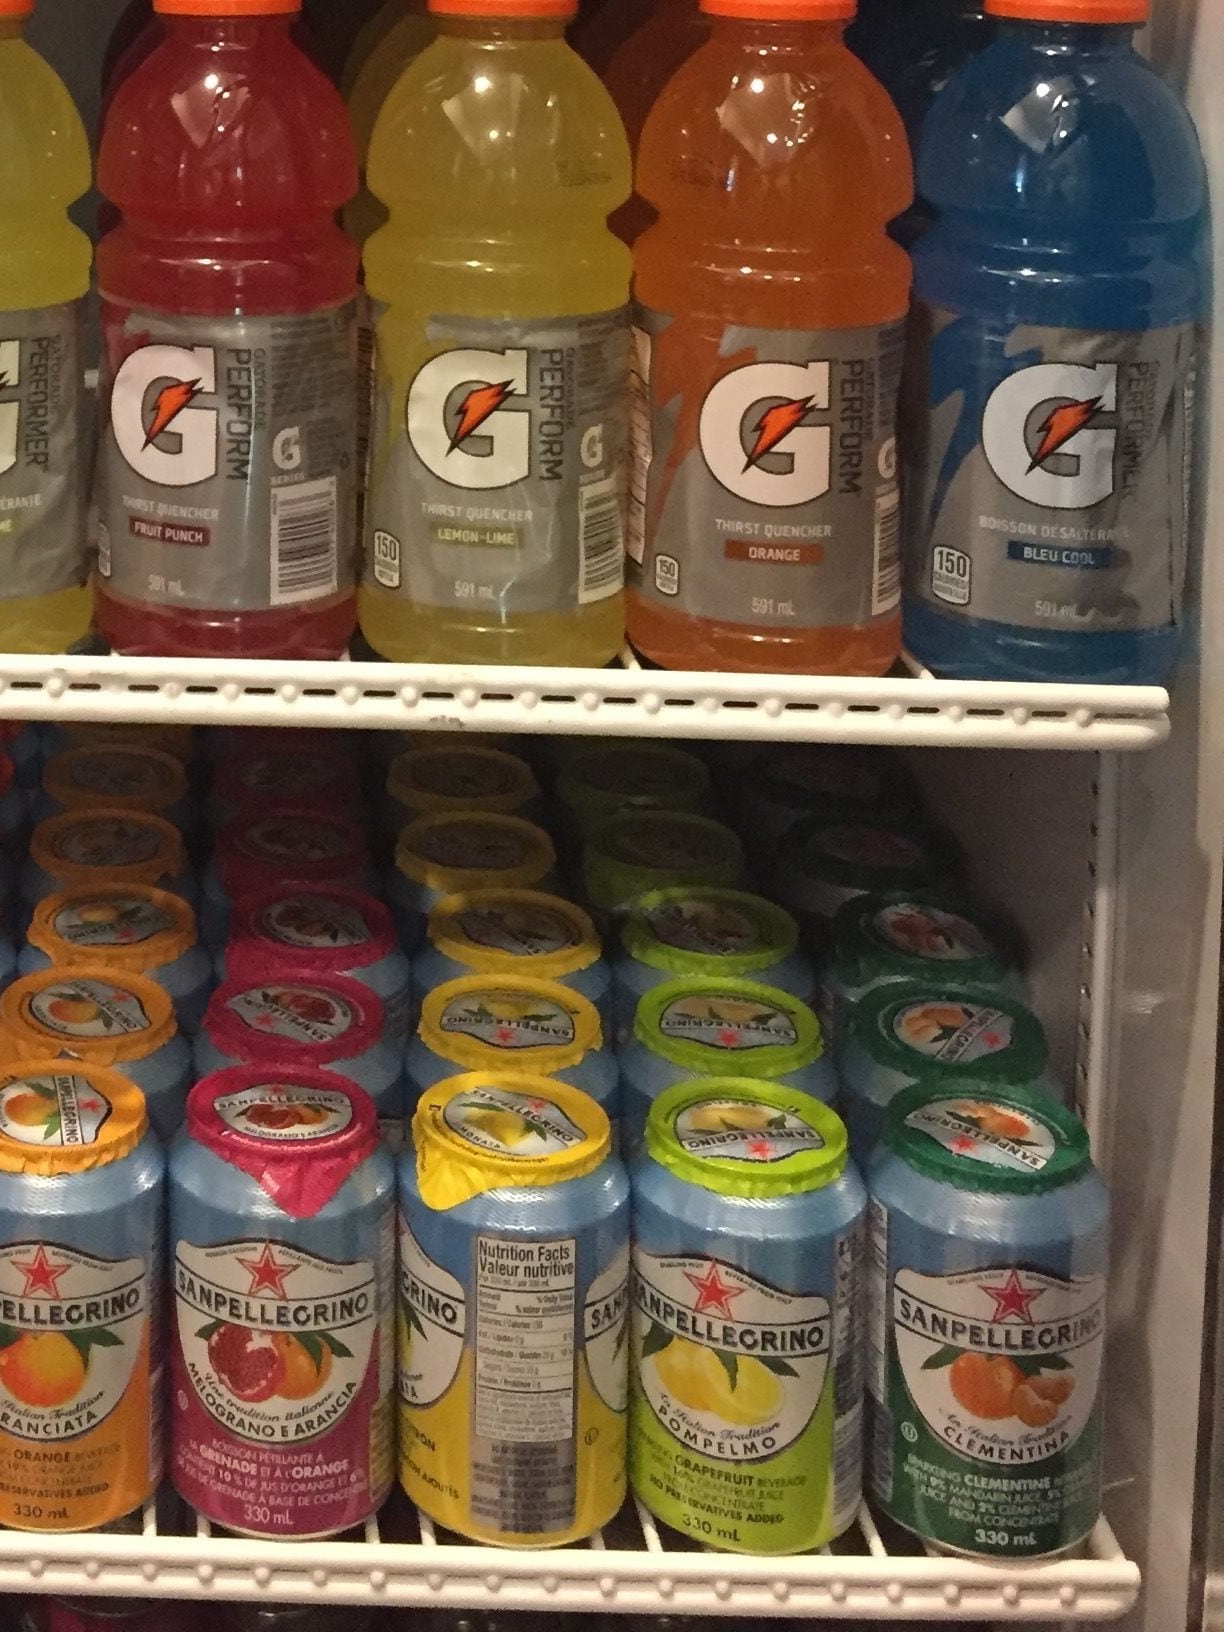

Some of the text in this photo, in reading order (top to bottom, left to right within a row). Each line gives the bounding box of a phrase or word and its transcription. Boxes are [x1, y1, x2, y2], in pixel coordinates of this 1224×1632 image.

[26, 336, 49, 469] PERFORMER
[226, 348, 252, 480] PERFORM
[538, 348, 564, 481] PERFORM
[111, 344, 217, 487] G
[407, 346, 531, 490] G
[839, 360, 863, 494] PERFORM
[580, 424, 603, 468] G
[699, 360, 831, 508] G
[982, 362, 1118, 510] G
[272, 426, 301, 470] G
[158, 502, 219, 520] QUENCHER
[422, 502, 533, 521] THIRST QUENCHER
[134, 521, 203, 543] FRUIT PUNCH
[437, 527, 514, 545] LEMON-LIME
[716, 519, 832, 538] THIRST QUENCHER
[979, 515, 1036, 535] BOISSON
[376, 534, 397, 561] 150
[748, 547, 801, 561] ORANGE
[1024, 547, 1096, 565] BLEU COOL
[659, 558, 675, 577] 150
[937, 549, 967, 578] 150
[455, 580, 476, 597] 591
[752, 598, 795, 616] 591 mL
[479, 1239, 570, 1262] Nutrition Facts
[479, 1256, 574, 1278] Valeur nutritive
[178, 1271, 369, 1326] SANPELLEGRINO
[639, 1281, 824, 1351] ANPELLEGRINO
[188, 1362, 357, 1438] MELOGRANO E ARANCIA
[658, 1404, 777, 1456] POMPELMO
[943, 1425, 1071, 1460] CLEMENTINA
[13, 1449, 71, 1463] ORANGE
[199, 1444, 258, 1476] GRENADE
[219, 1469, 232, 1482] 10
[260, 1479, 277, 1492] JUS
[676, 1454, 755, 1485] GRAPEFRUIT
[964, 1474, 1051, 1490] CLEMENTINE
[13, 1503, 43, 1518] 330
[268, 1495, 310, 1507] BASE DE
[243, 1505, 294, 1526] 330 mL
[682, 1513, 741, 1543] 330 mL
[974, 1528, 1009, 1546] 330
